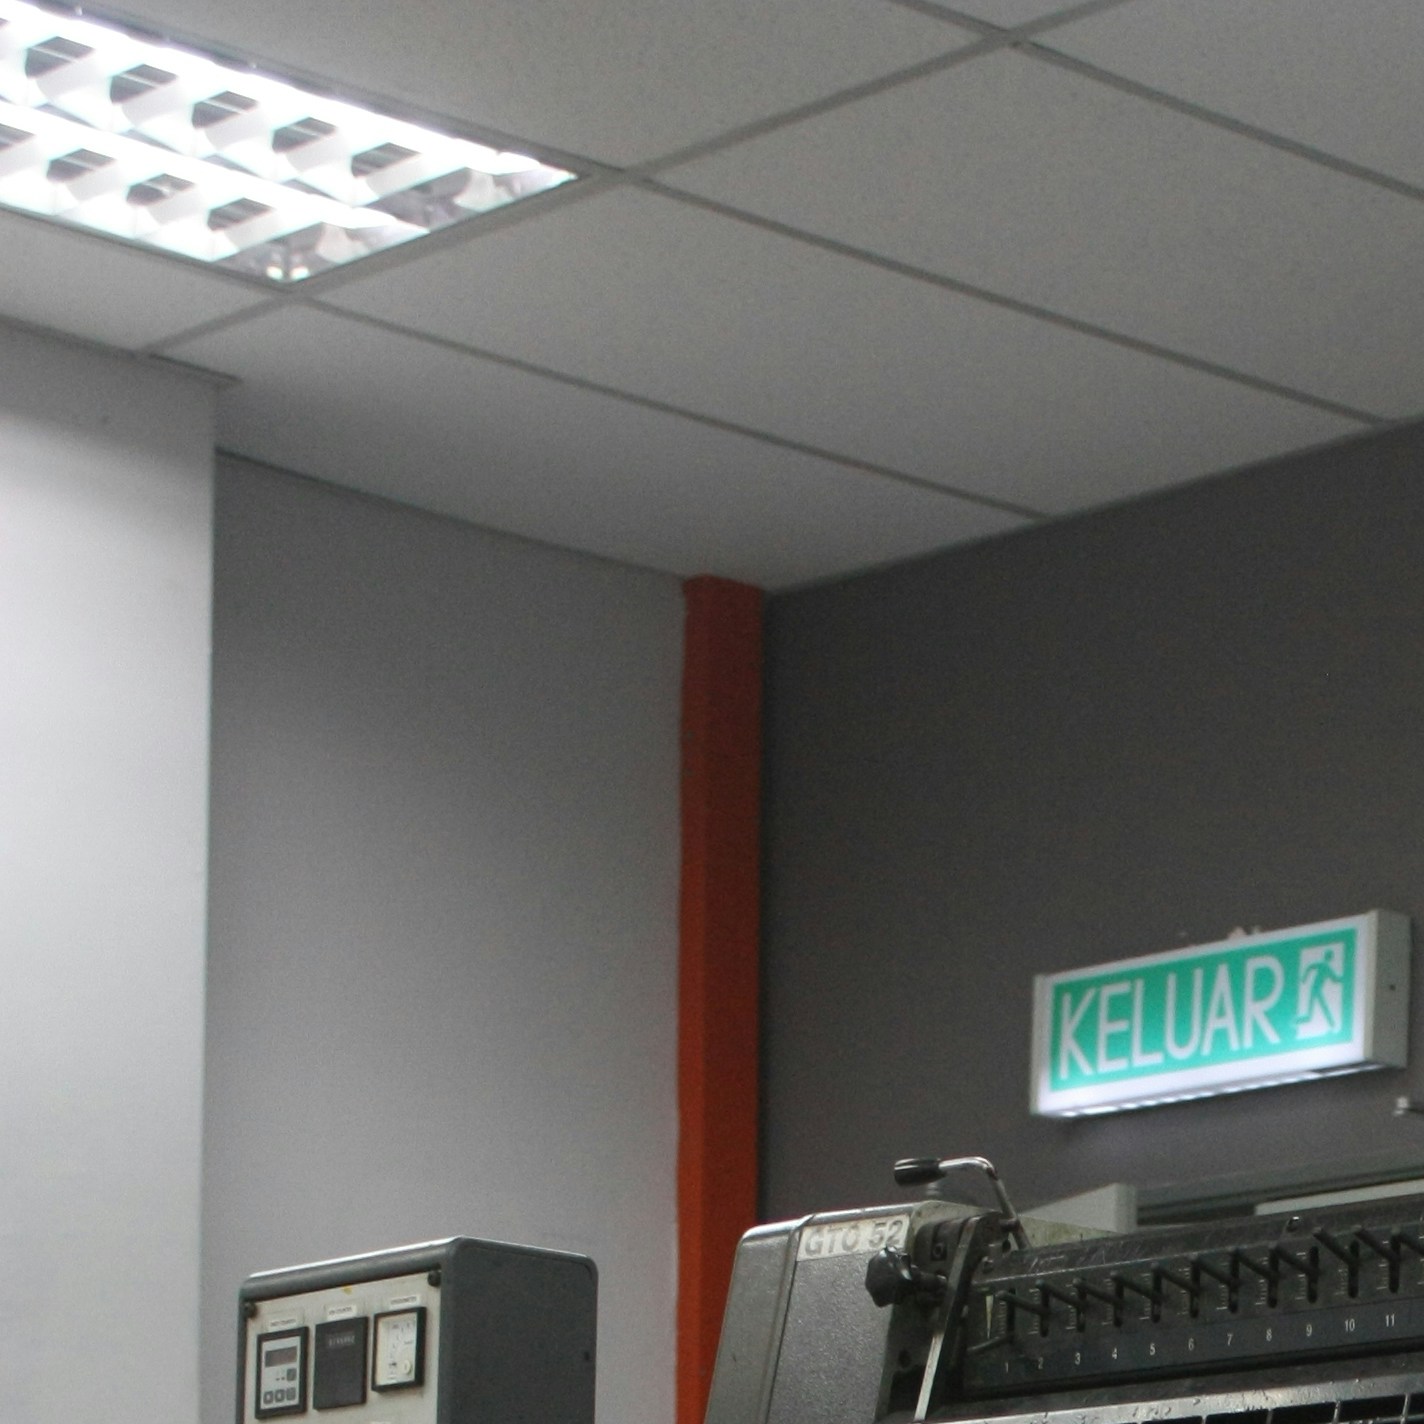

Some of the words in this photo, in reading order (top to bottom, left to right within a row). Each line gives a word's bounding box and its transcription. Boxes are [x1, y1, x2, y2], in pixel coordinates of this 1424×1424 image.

[1059, 955, 1284, 1080] KELUAR
[804, 1225, 860, 1256] GTO
[868, 1219, 904, 1248] 52
[1005, 1361, 1010, 1373] 1
[1037, 1357, 1045, 1370] 2
[1075, 1352, 1081, 1365] 3
[1111, 1348, 1118, 1360] 4
[1150, 1343, 1156, 1356] 5
[1188, 1338, 1195, 1351] 6
[1227, 1333, 1234, 1346] 7
[1266, 1328, 1272, 1341] 8
[1306, 1323, 1313, 1337] 9
[1344, 1318, 1356, 1332] 10
[1385, 1314, 1396, 1328] 11
